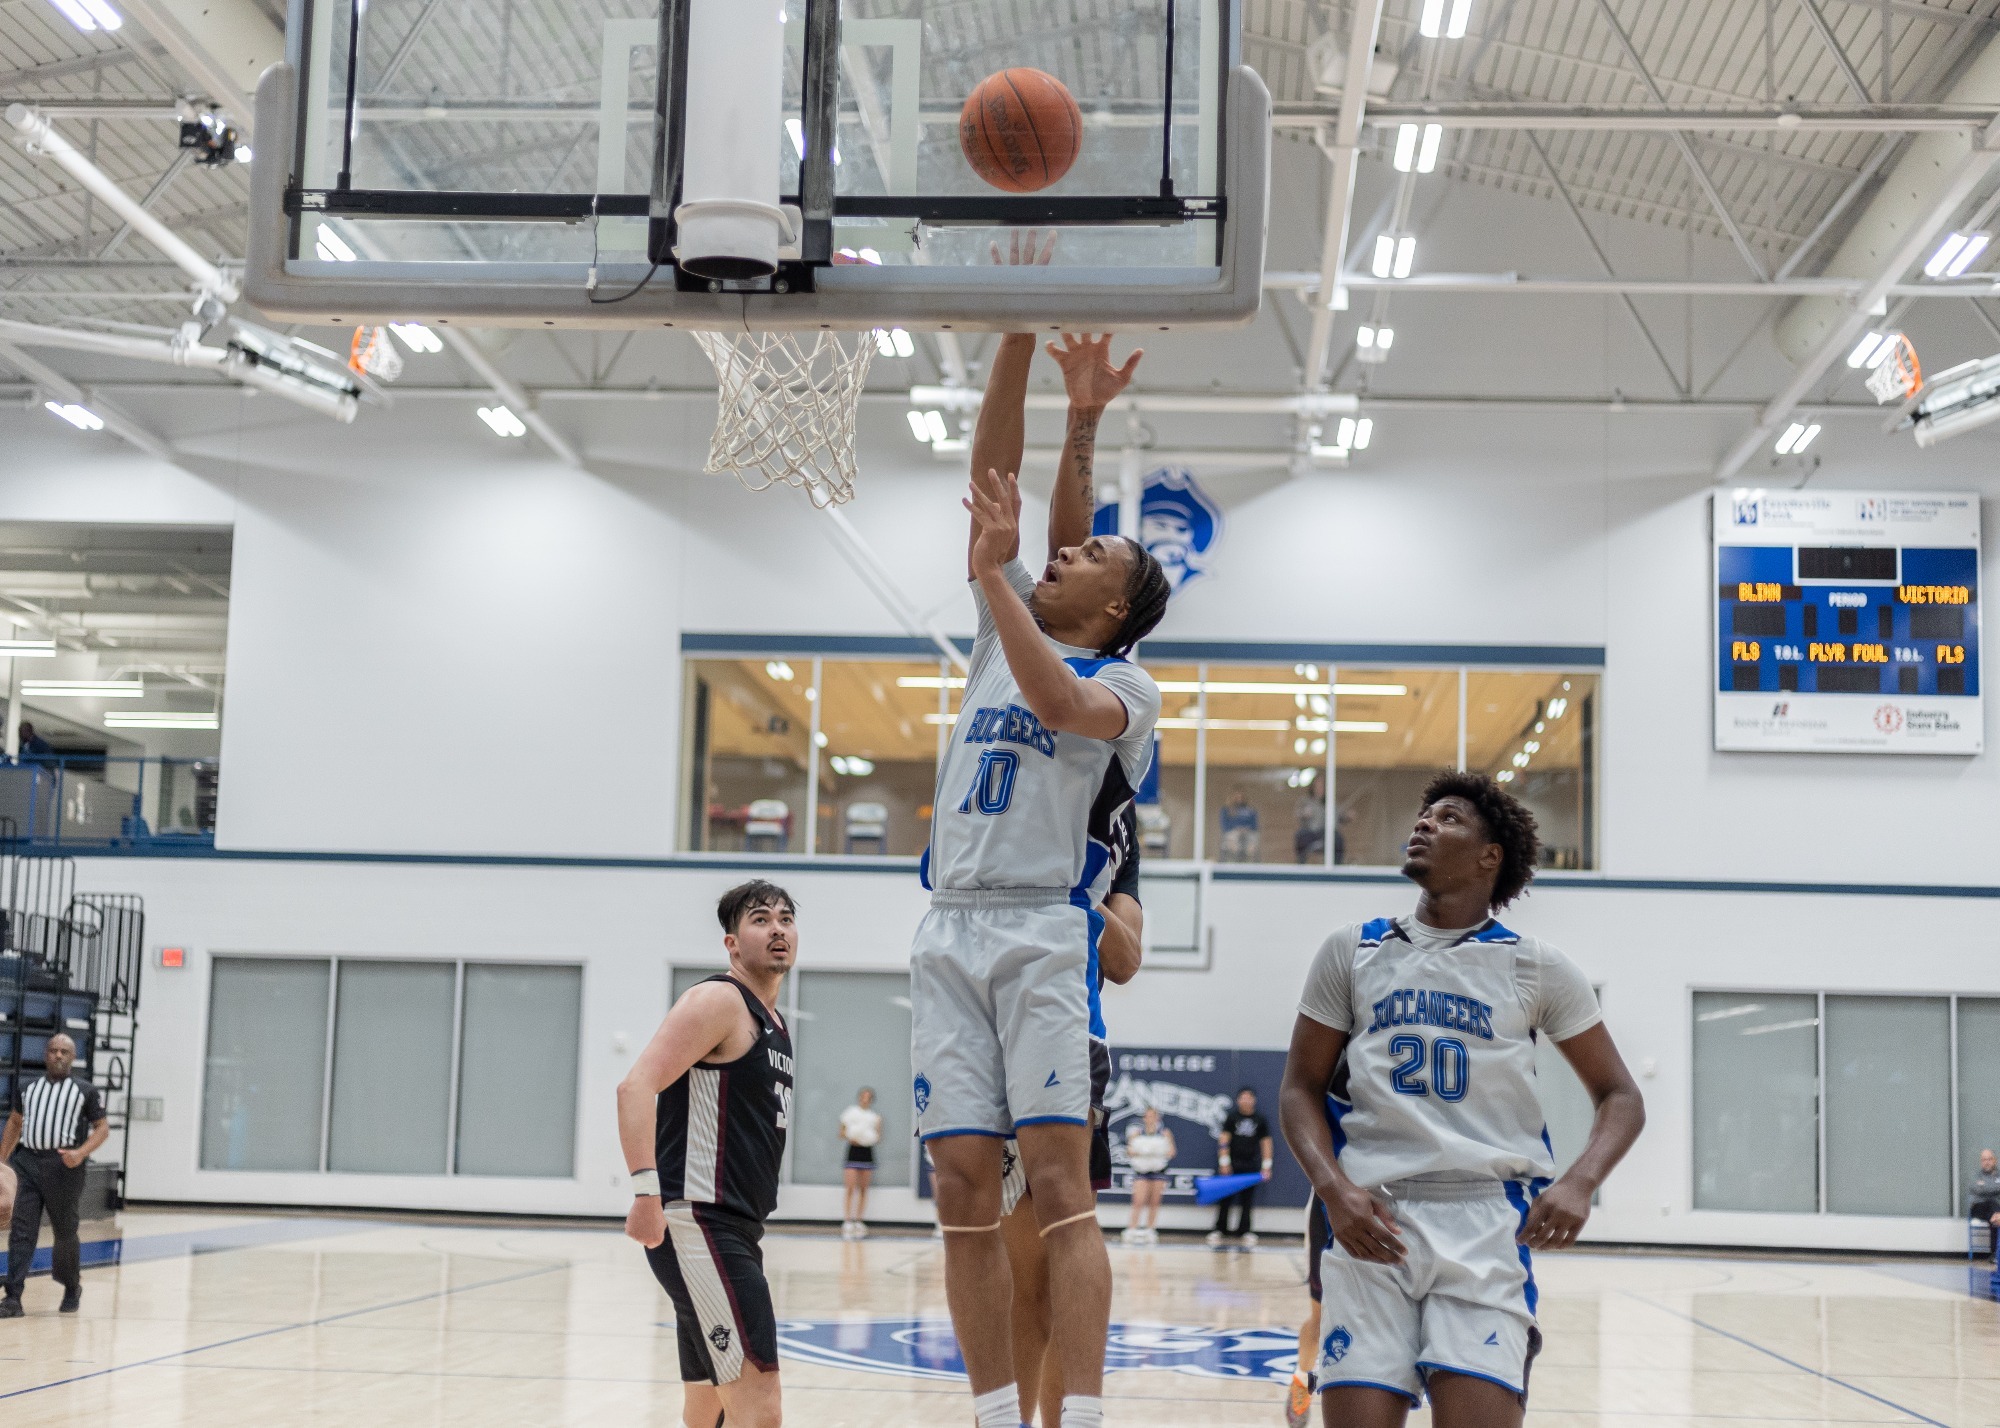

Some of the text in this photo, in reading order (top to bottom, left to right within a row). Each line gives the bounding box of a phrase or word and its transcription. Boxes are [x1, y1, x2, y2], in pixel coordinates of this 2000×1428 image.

[1738, 582, 1782, 602] BLINN
[1829, 592, 1868, 607] PERIOD
[1899, 585, 1969, 604] VICTORIA
[1732, 641, 1761, 661] FLS
[1809, 642, 1889, 663] PLYR FOUL
[1936, 645, 1965, 663] FLS
[958, 748, 1020, 815] 10
[1118, 1054, 1216, 1072] COLLEGE
[1389, 1033, 1470, 1103] 20
